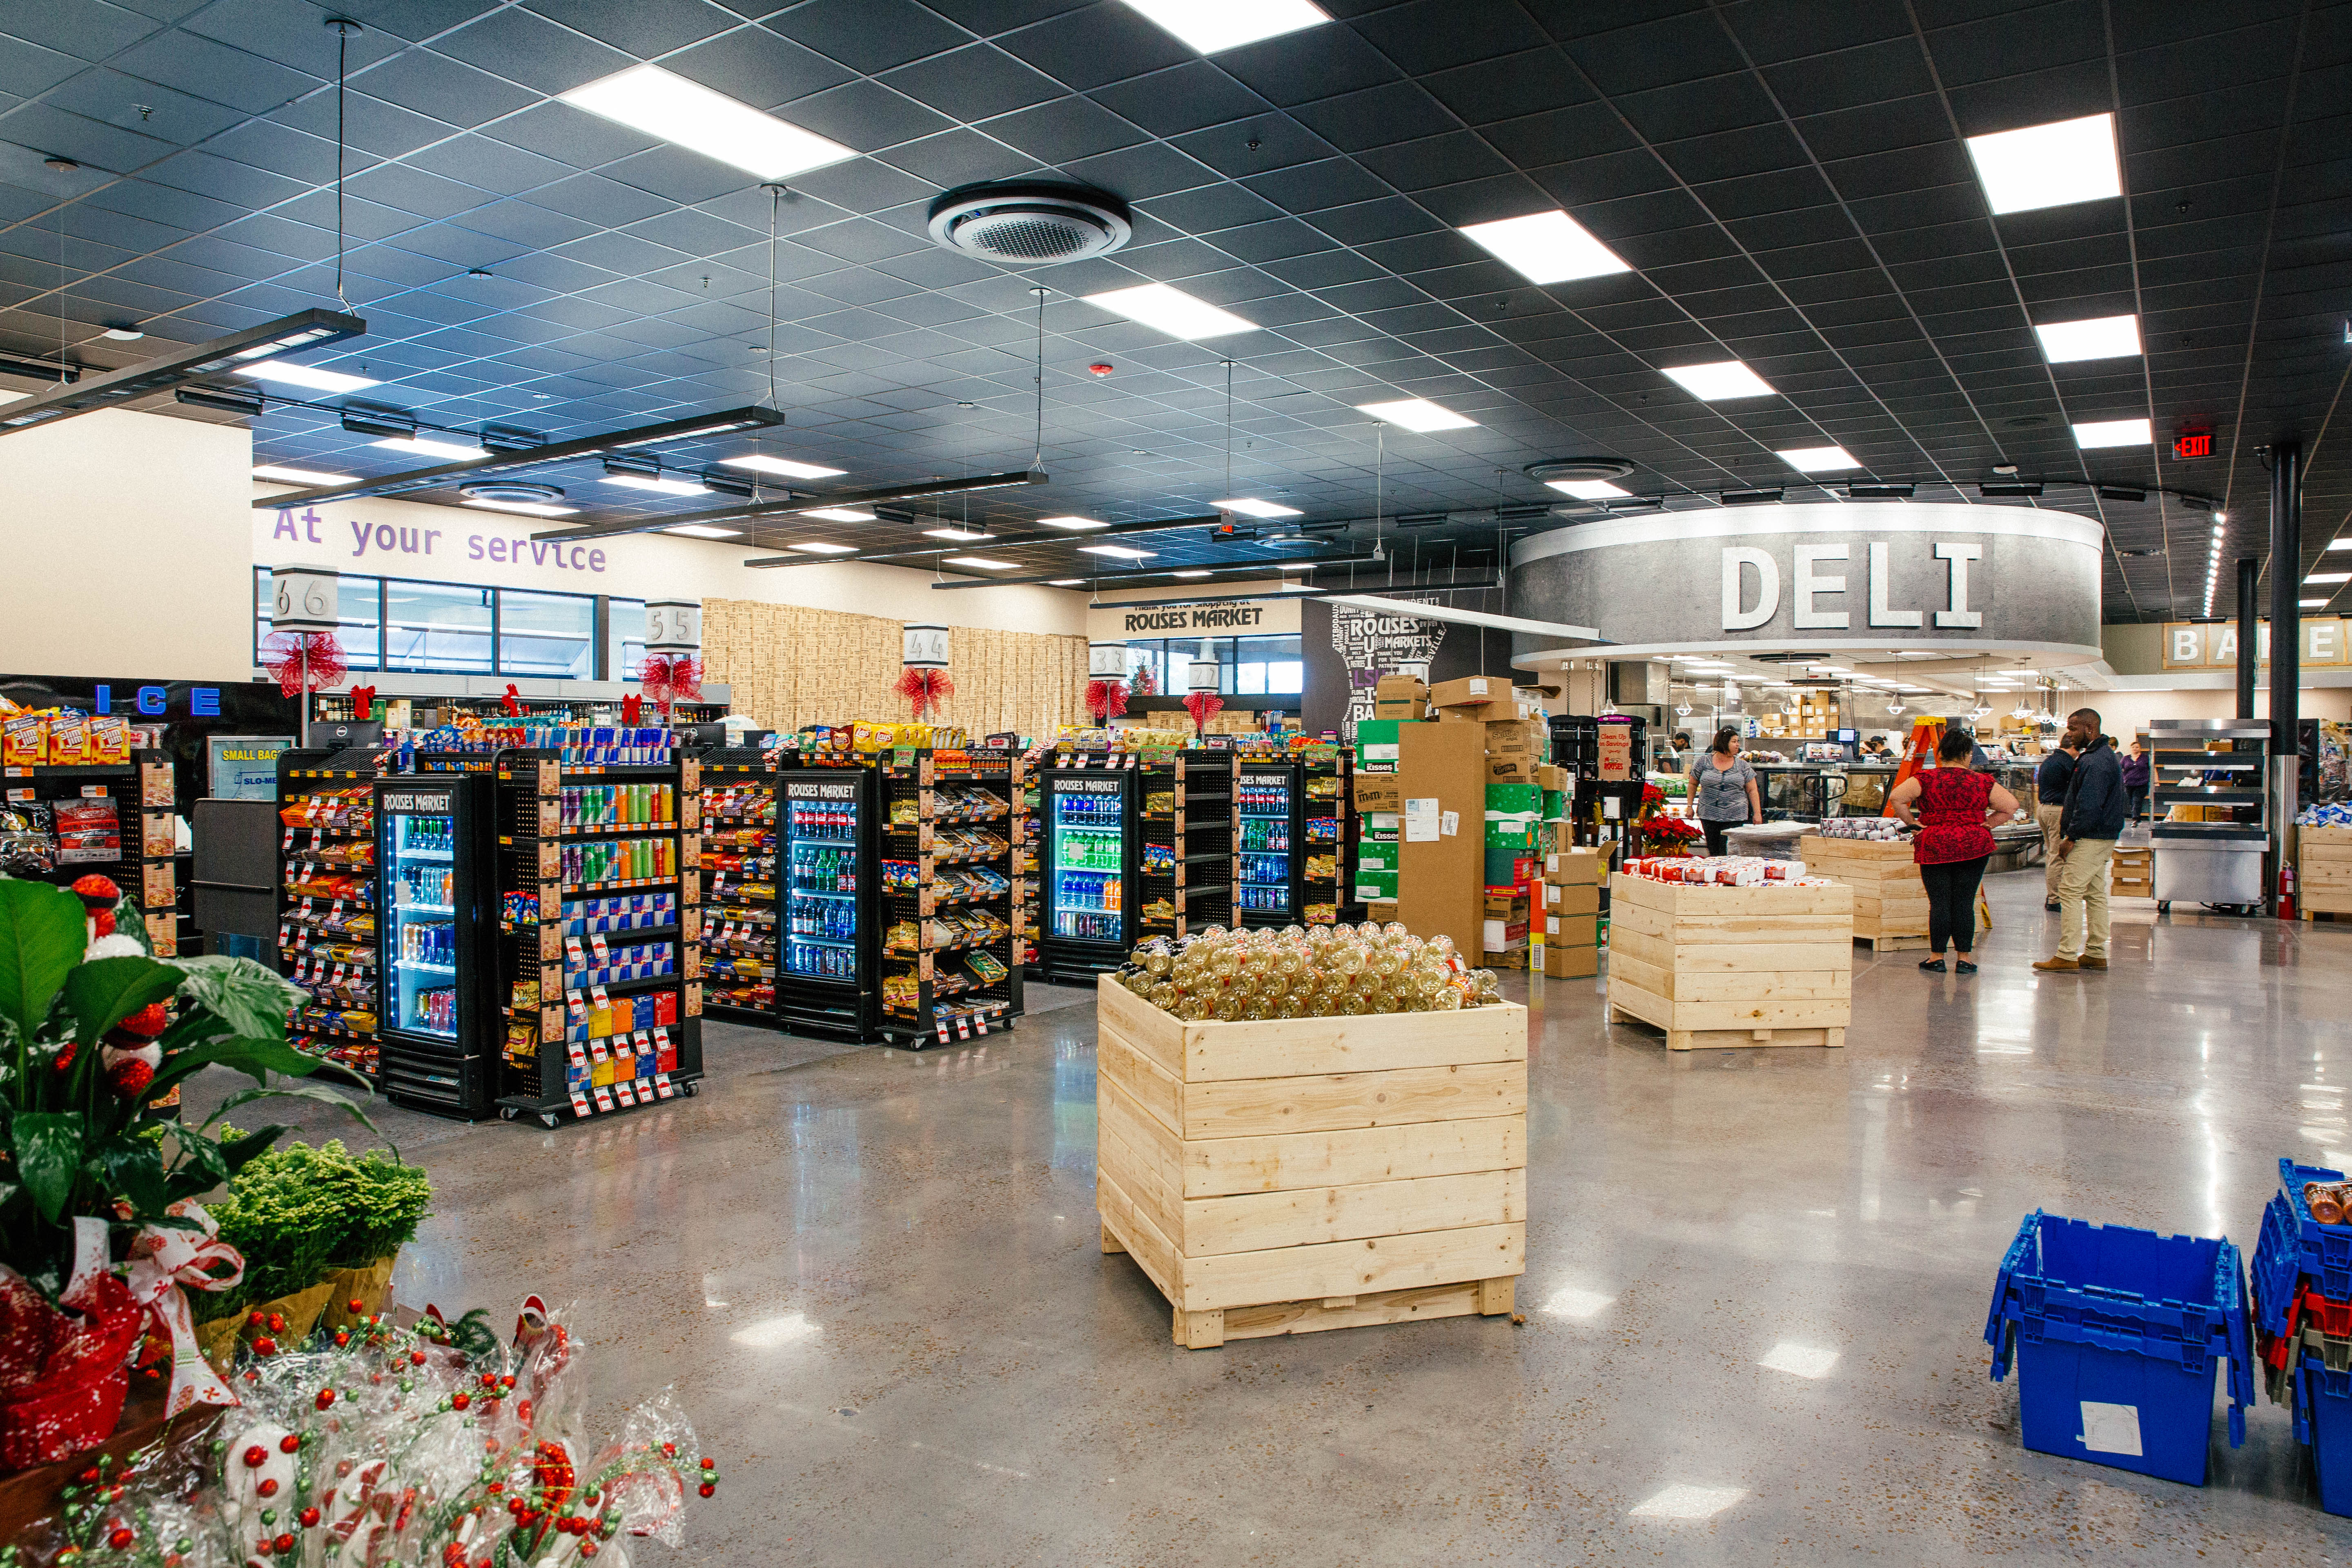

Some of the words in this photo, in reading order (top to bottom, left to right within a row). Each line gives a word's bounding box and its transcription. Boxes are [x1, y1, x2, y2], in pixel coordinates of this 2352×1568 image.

[2181, 435, 2211, 457] EXIT
[274, 507, 322, 543] At
[351, 521, 441, 557] your
[469, 534, 606, 572] service
[1722, 542, 1982, 630] DELI
[277, 580, 290, 615] 6
[304, 580, 326, 615] 6
[651, 611, 664, 640] 5
[676, 611, 689, 640] 5
[1125, 612, 1187, 632] ROUSES
[1193, 608, 1263, 628] MARKET
[1350, 617, 1419, 637] ROUSES
[909, 633, 923, 658] 4
[931, 634, 944, 659] 4
[1385, 635, 1432, 649] MARKETS
[1095, 650, 1106, 672] 3
[1114, 650, 1122, 672] 3
[1191, 668, 1202, 686] 2
[1209, 667, 1216, 686] 2
[1354, 670, 1385, 686] LSU
[95, 685, 221, 717] ICE
[7, 722, 18, 731] 14
[53, 722, 64, 731] 14
[94, 722, 104, 731] 14
[1493, 729, 1519, 739] Skittles
[223, 750, 255, 761] SMALL
[258, 749, 282, 760] BAG
[1054, 780, 1084, 791] ROUSES
[1085, 781, 1119, 792] MARKET
[1256, 776, 1286, 785] MARKET
[788, 784, 818, 799] ROUSES
[820, 785, 855, 799] MARKET
[383, 795, 413, 811] ROUSES
[416, 795, 450, 811] MARKET
